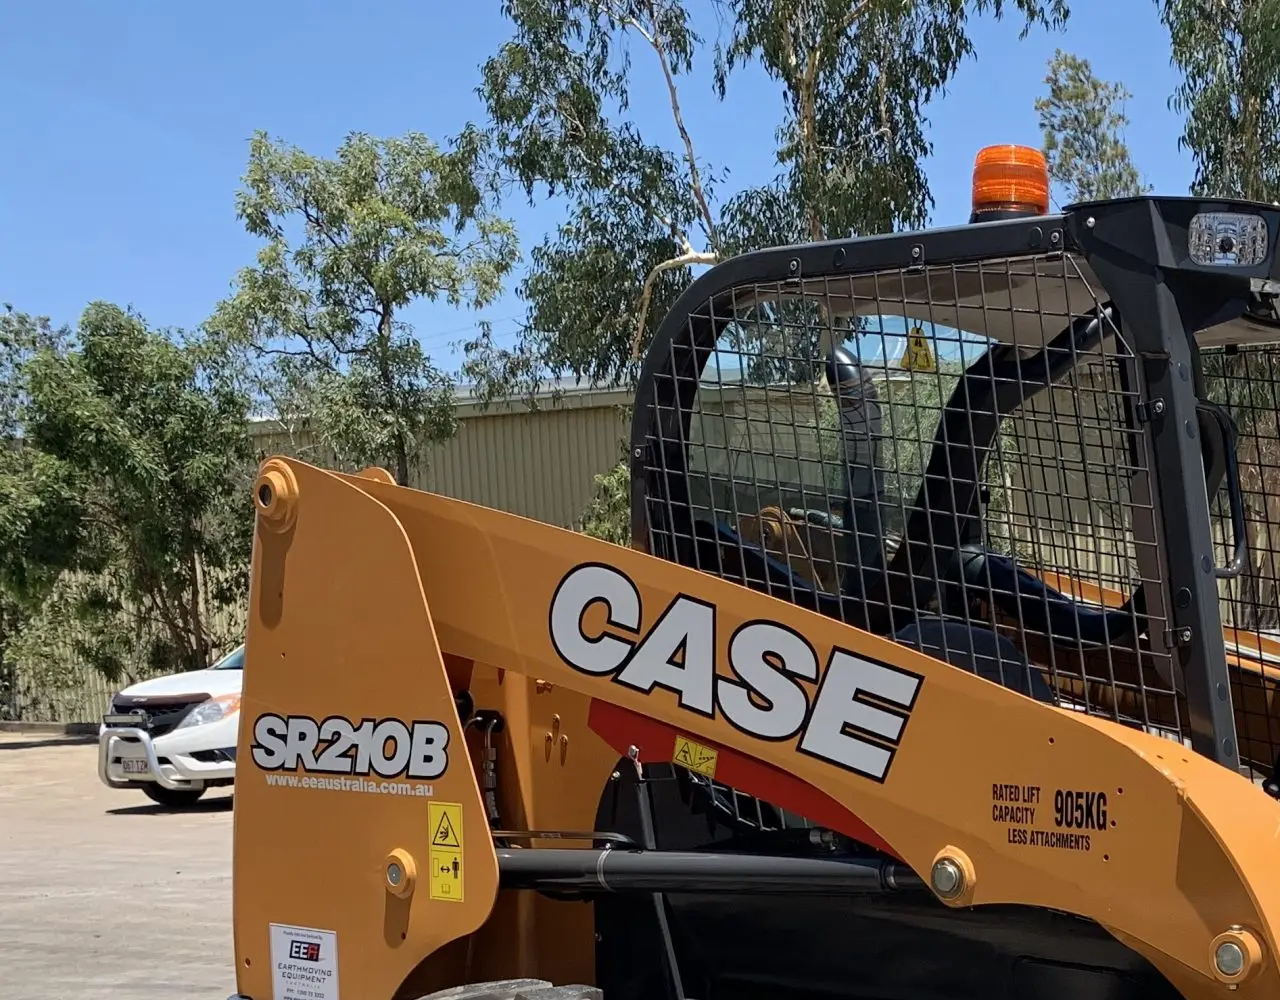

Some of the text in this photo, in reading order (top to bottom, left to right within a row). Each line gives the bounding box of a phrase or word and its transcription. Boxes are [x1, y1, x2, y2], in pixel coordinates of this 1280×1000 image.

[549, 561, 925, 784] CASE
[250, 713, 450, 780] SR210B
[266, 773, 433, 797] www.eeaustralia.com.au
[992, 784, 1041, 804] RATED LIFT
[992, 804, 1035, 825] CAPACITY
[1054, 789, 1107, 831] 905KG
[1008, 828, 1091, 851] LESS ATTACHMENTS
[278, 963, 332, 977] EARTHMOVING
[282, 971, 327, 984] EQUIPMENT
